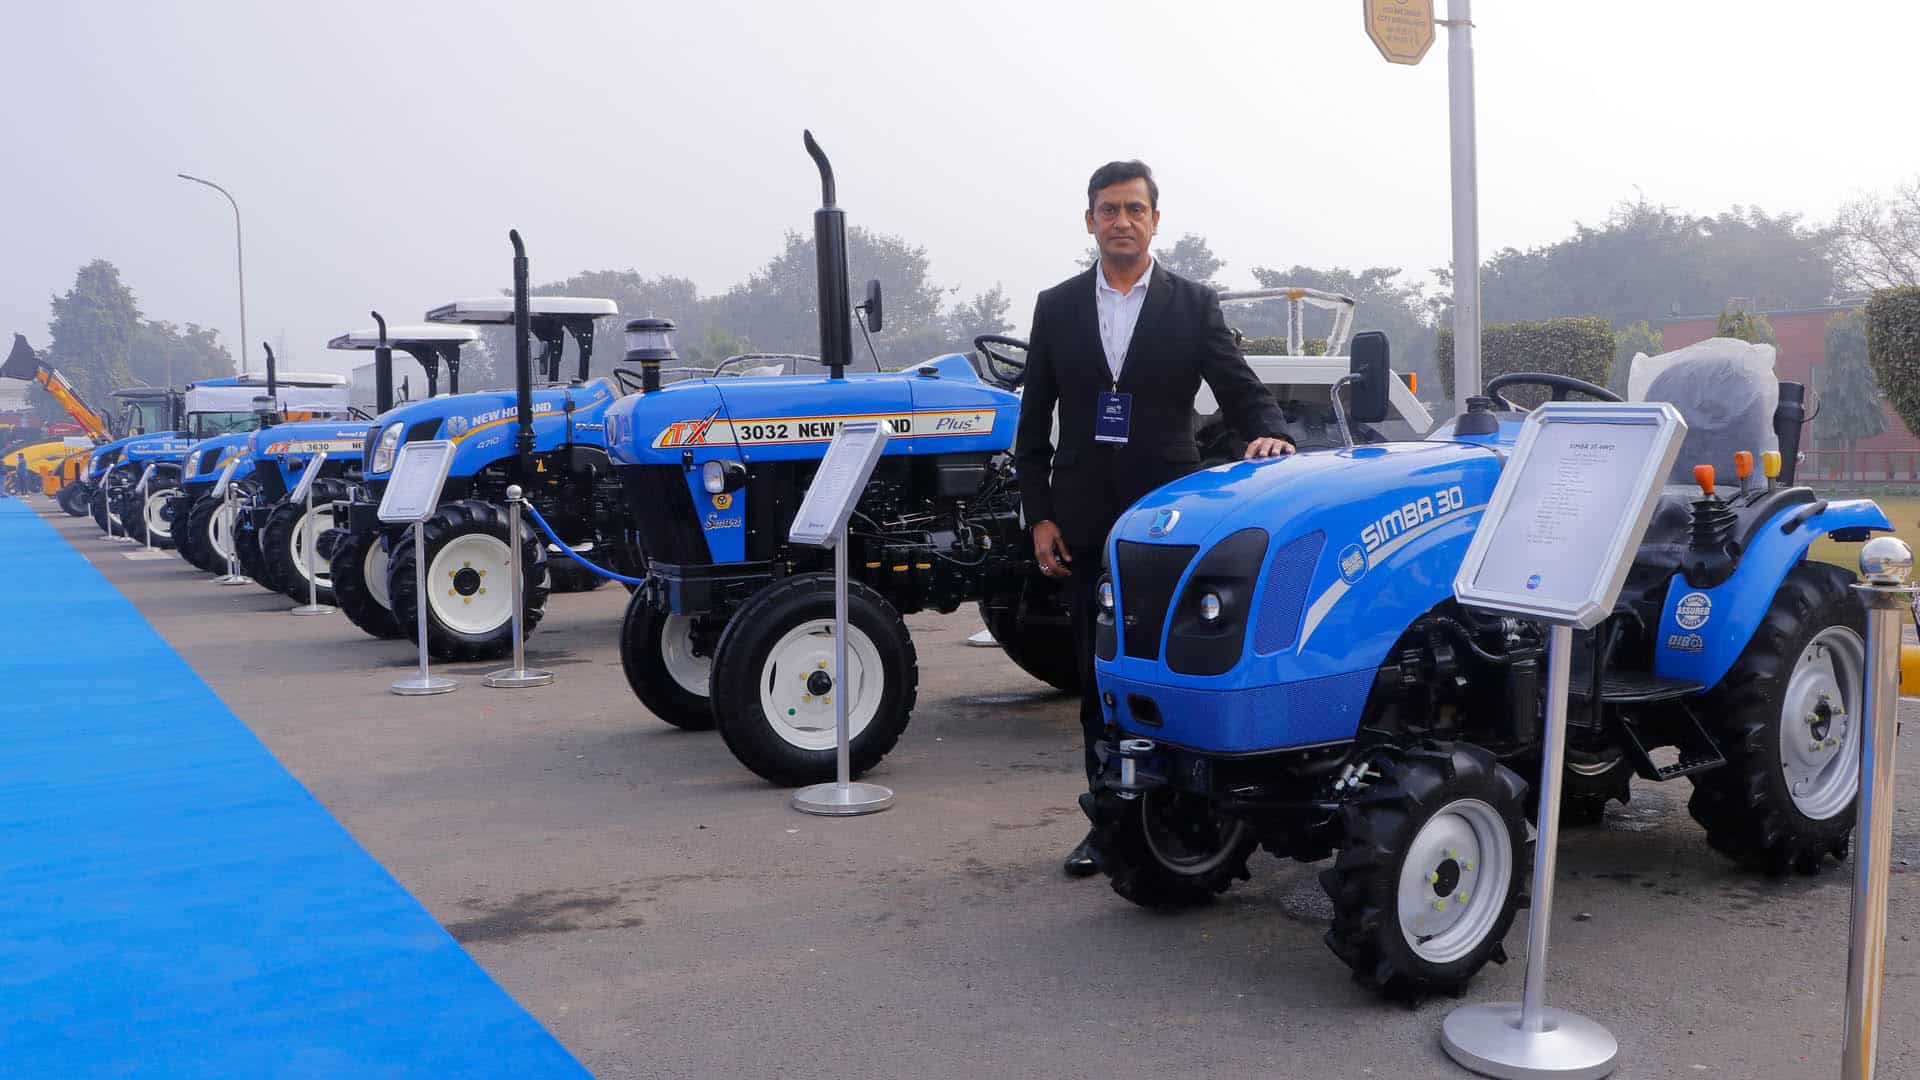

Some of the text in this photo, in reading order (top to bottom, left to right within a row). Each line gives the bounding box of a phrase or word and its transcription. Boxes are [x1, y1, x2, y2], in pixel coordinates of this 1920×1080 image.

[472, 409, 500, 427] NEW
[671, 411, 718, 445] TX
[740, 425, 788, 440] 3032
[798, 422, 835, 438] NEW
[308, 443, 329, 451] 3630
[1361, 486, 1464, 553] SIMBA 30
[1676, 607, 1711, 616] ASSURED
